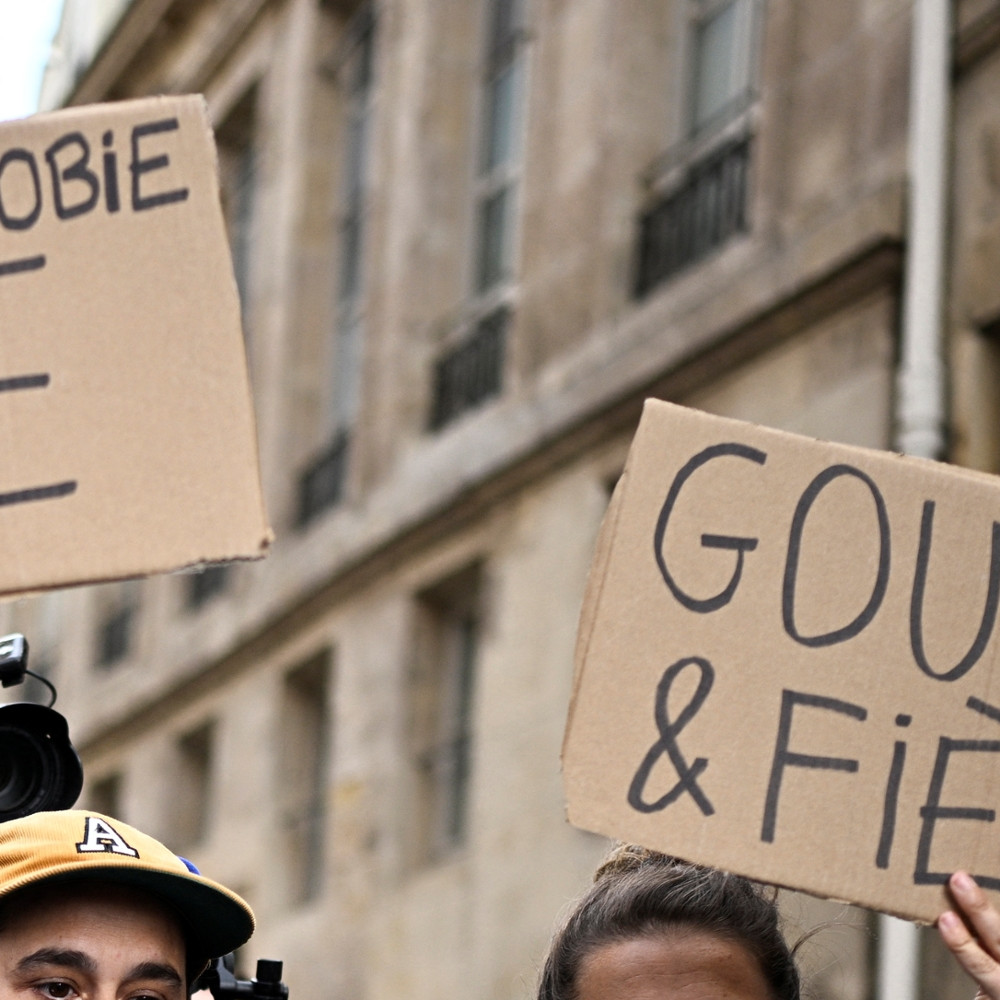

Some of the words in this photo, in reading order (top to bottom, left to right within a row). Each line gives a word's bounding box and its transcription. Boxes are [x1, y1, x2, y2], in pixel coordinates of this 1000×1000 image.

[653, 441, 1000, 683] GOU
[627, 655, 716, 817] &
[76, 816, 140, 859] A
